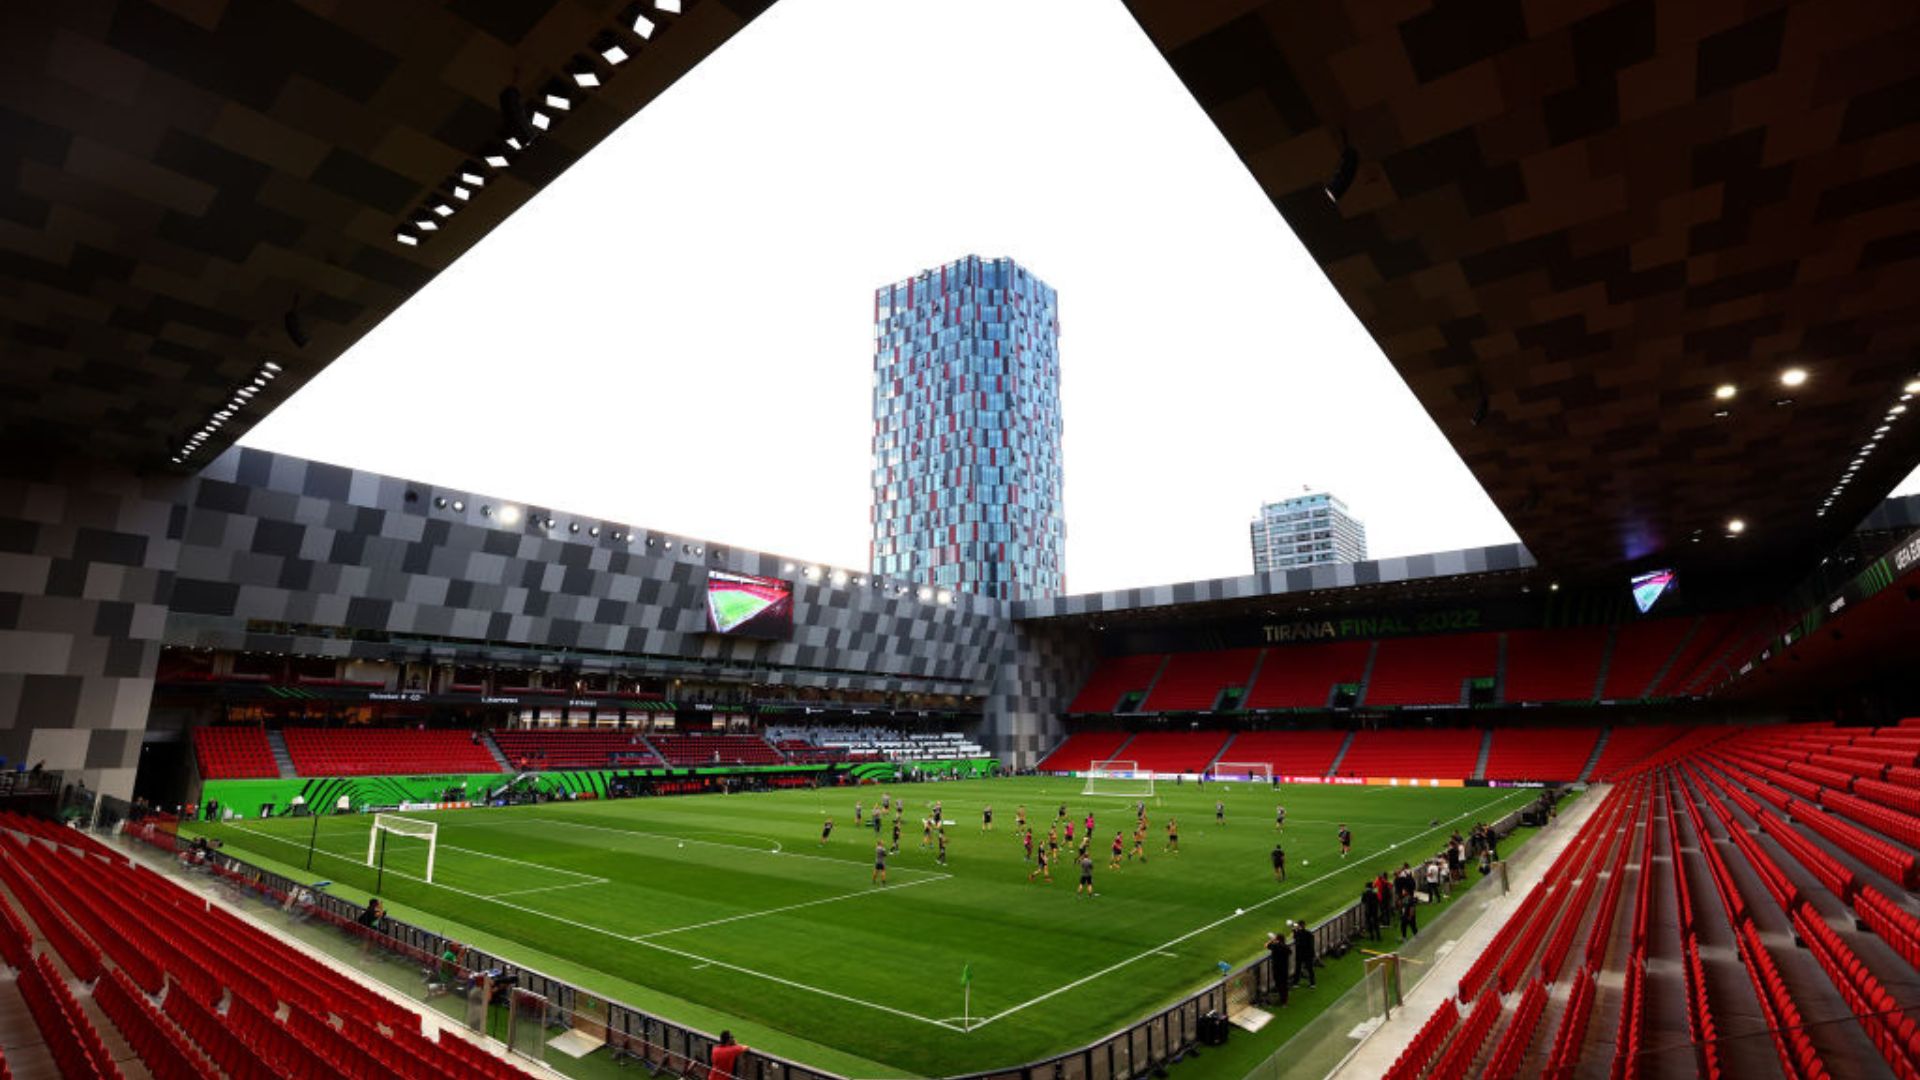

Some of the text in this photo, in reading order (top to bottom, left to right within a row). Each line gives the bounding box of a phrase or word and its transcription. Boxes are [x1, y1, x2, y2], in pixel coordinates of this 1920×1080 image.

[1263, 608, 1483, 642] TIRANA FINAL 2022
